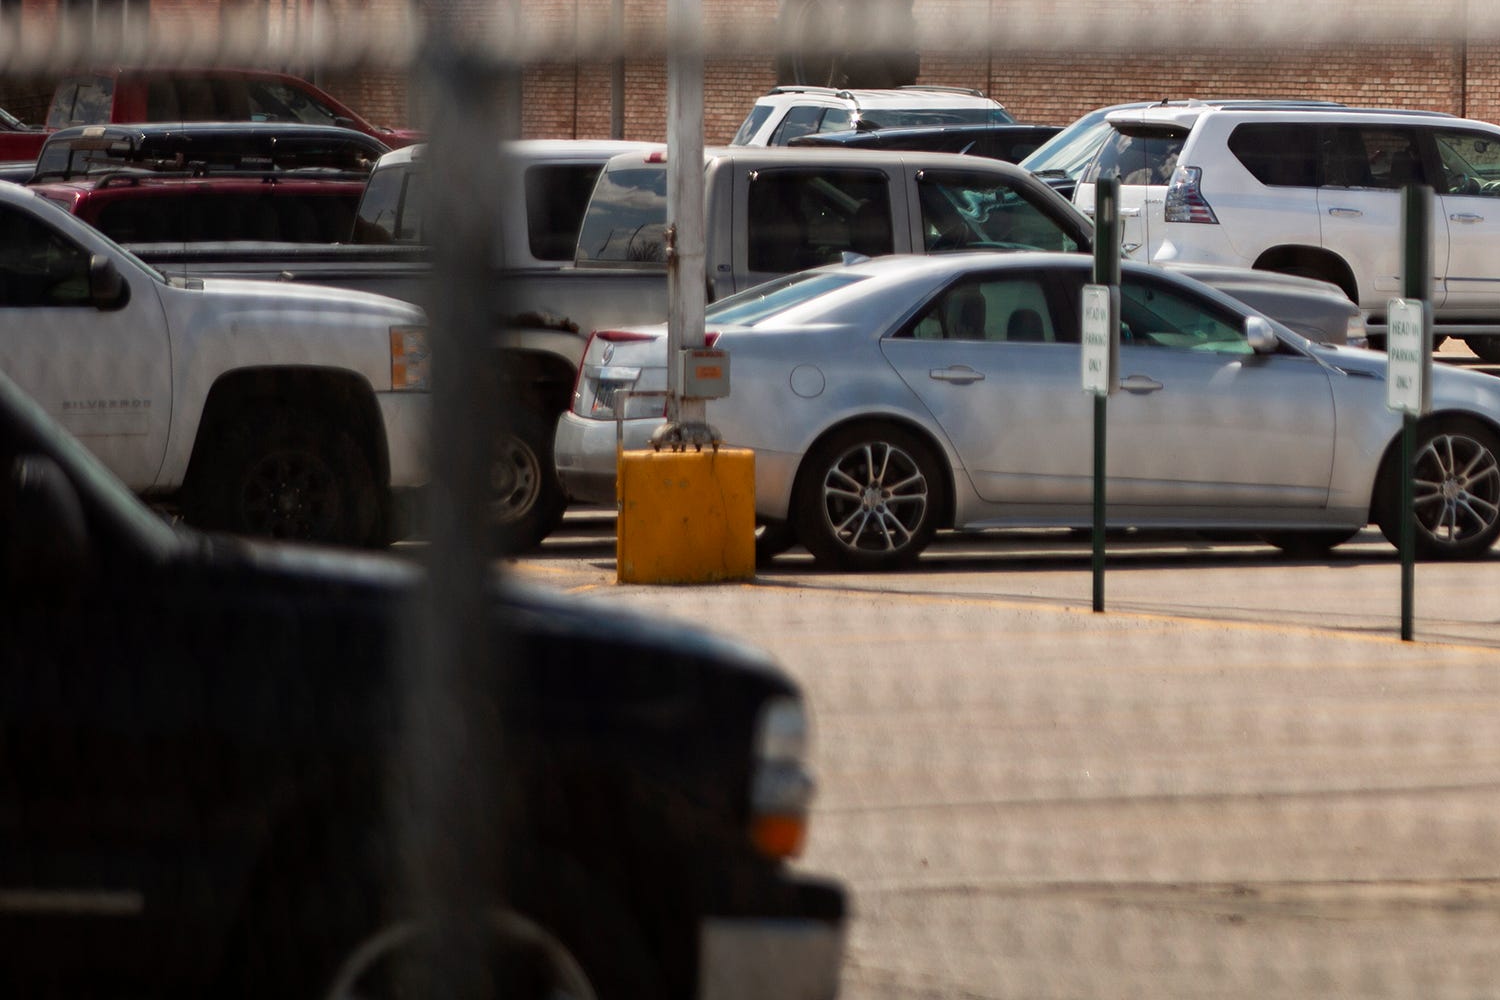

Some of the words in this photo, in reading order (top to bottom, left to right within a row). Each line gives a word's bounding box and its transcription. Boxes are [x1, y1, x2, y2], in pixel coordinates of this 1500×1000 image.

[1086, 308, 1101, 320] HEAD
[1392, 321, 1409, 336] HEAD
[1085, 332, 1107, 345] PARKING
[1391, 349, 1420, 362] PARKING
[1088, 359, 1102, 372] ONLY
[1395, 376, 1412, 389] ONLY
